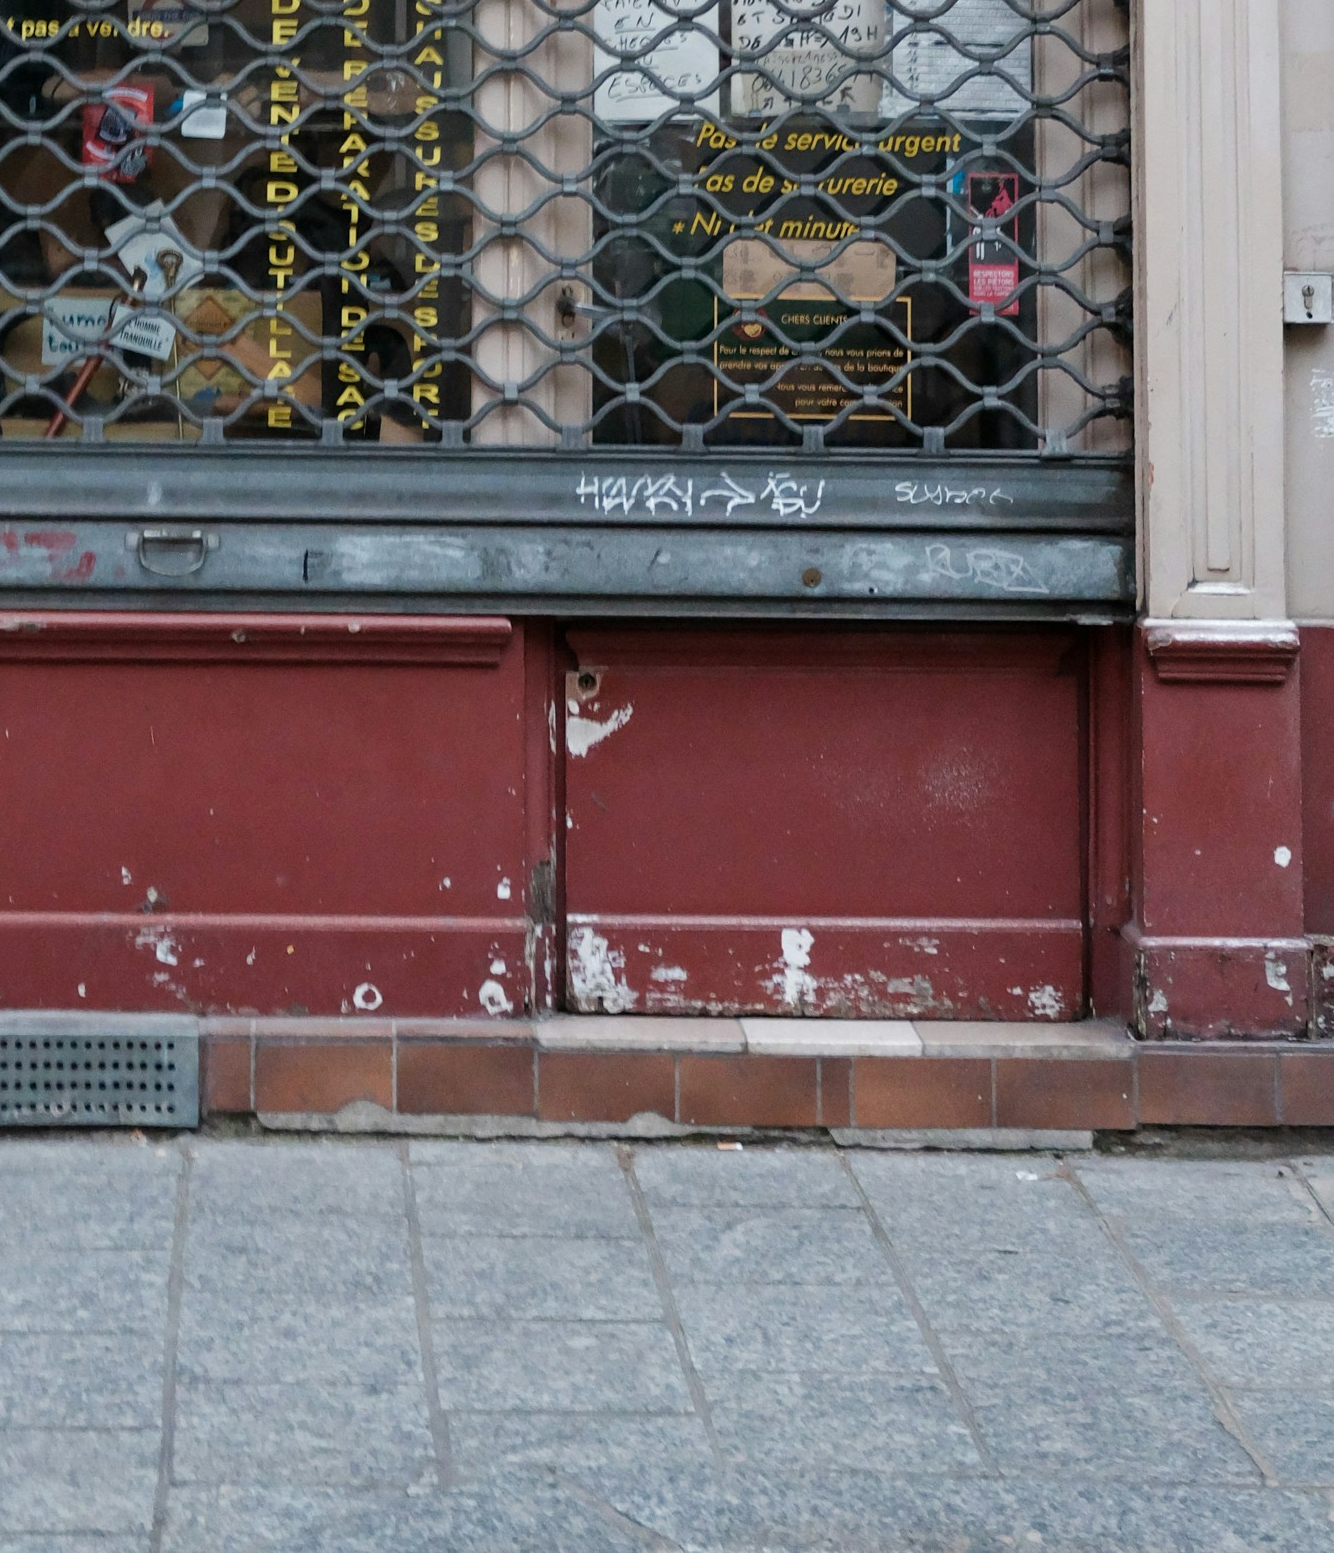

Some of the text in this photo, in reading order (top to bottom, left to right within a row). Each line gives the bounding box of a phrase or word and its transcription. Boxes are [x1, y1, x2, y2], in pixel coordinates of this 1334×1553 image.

[696, 122, 737, 149] Pas
[878, 132, 962, 158] urgent
[741, 165, 775, 194] de
[780, 313, 811, 326] CHERS
